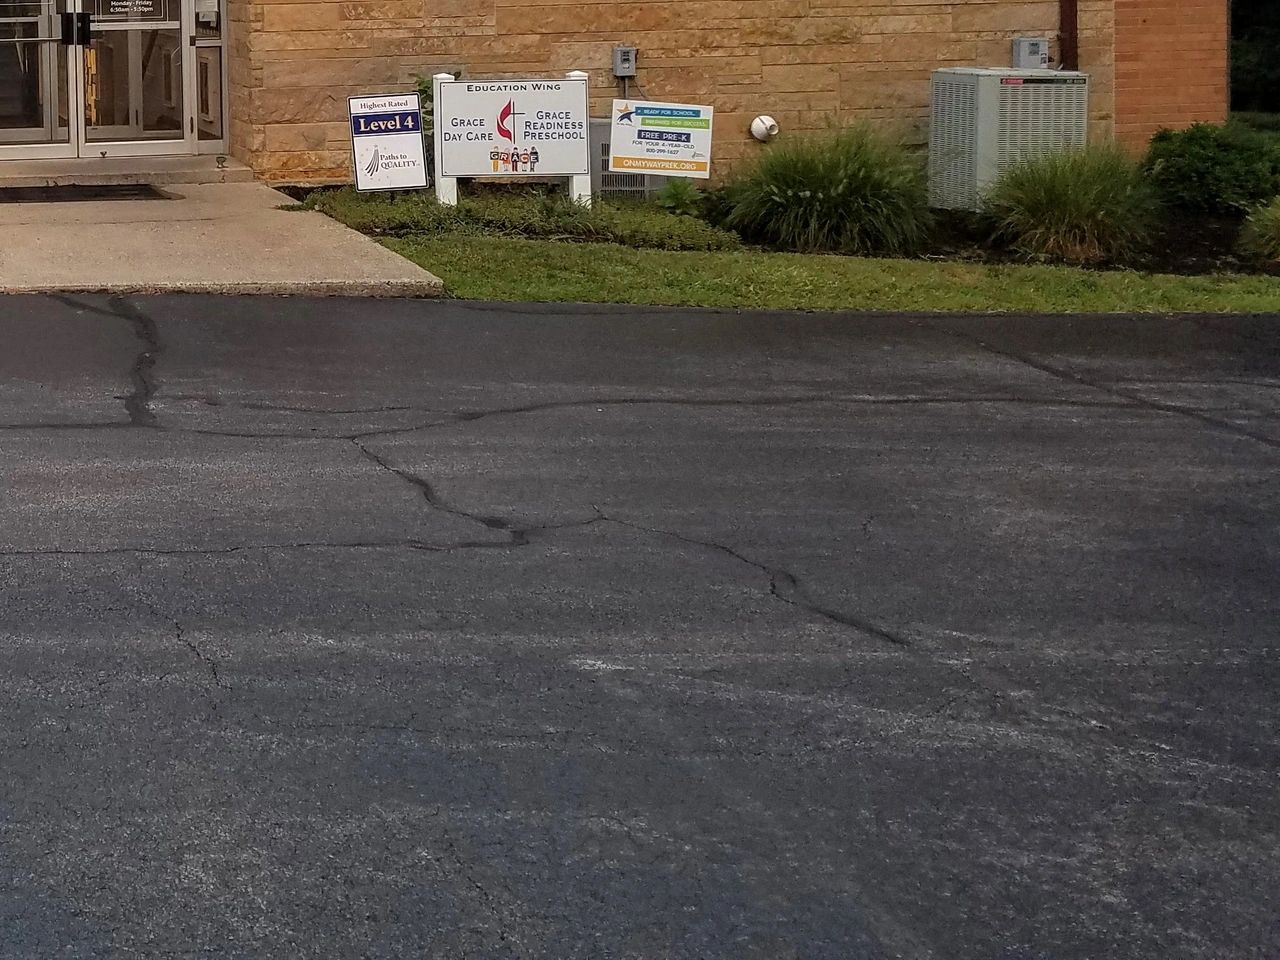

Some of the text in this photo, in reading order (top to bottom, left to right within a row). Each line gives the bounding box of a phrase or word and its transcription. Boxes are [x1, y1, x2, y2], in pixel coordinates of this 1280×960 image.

[467, 83, 561, 92] EDUCATION WING
[360, 102, 387, 110] Highest
[536, 110, 571, 120] GRACE
[358, 115, 414, 131] Level 4
[451, 118, 485, 127] GRACE
[524, 121, 584, 130] READINESS
[444, 132, 494, 141] DAY CARE
[523, 131, 585, 140] PRESCHOOL
[641, 131, 688, 141] FREE PRE-K
[490, 152, 539, 162] GRACE
[380, 160, 417, 169] QUALITY
[623, 159, 697, 170] ONMYWAYPREK.ORG
